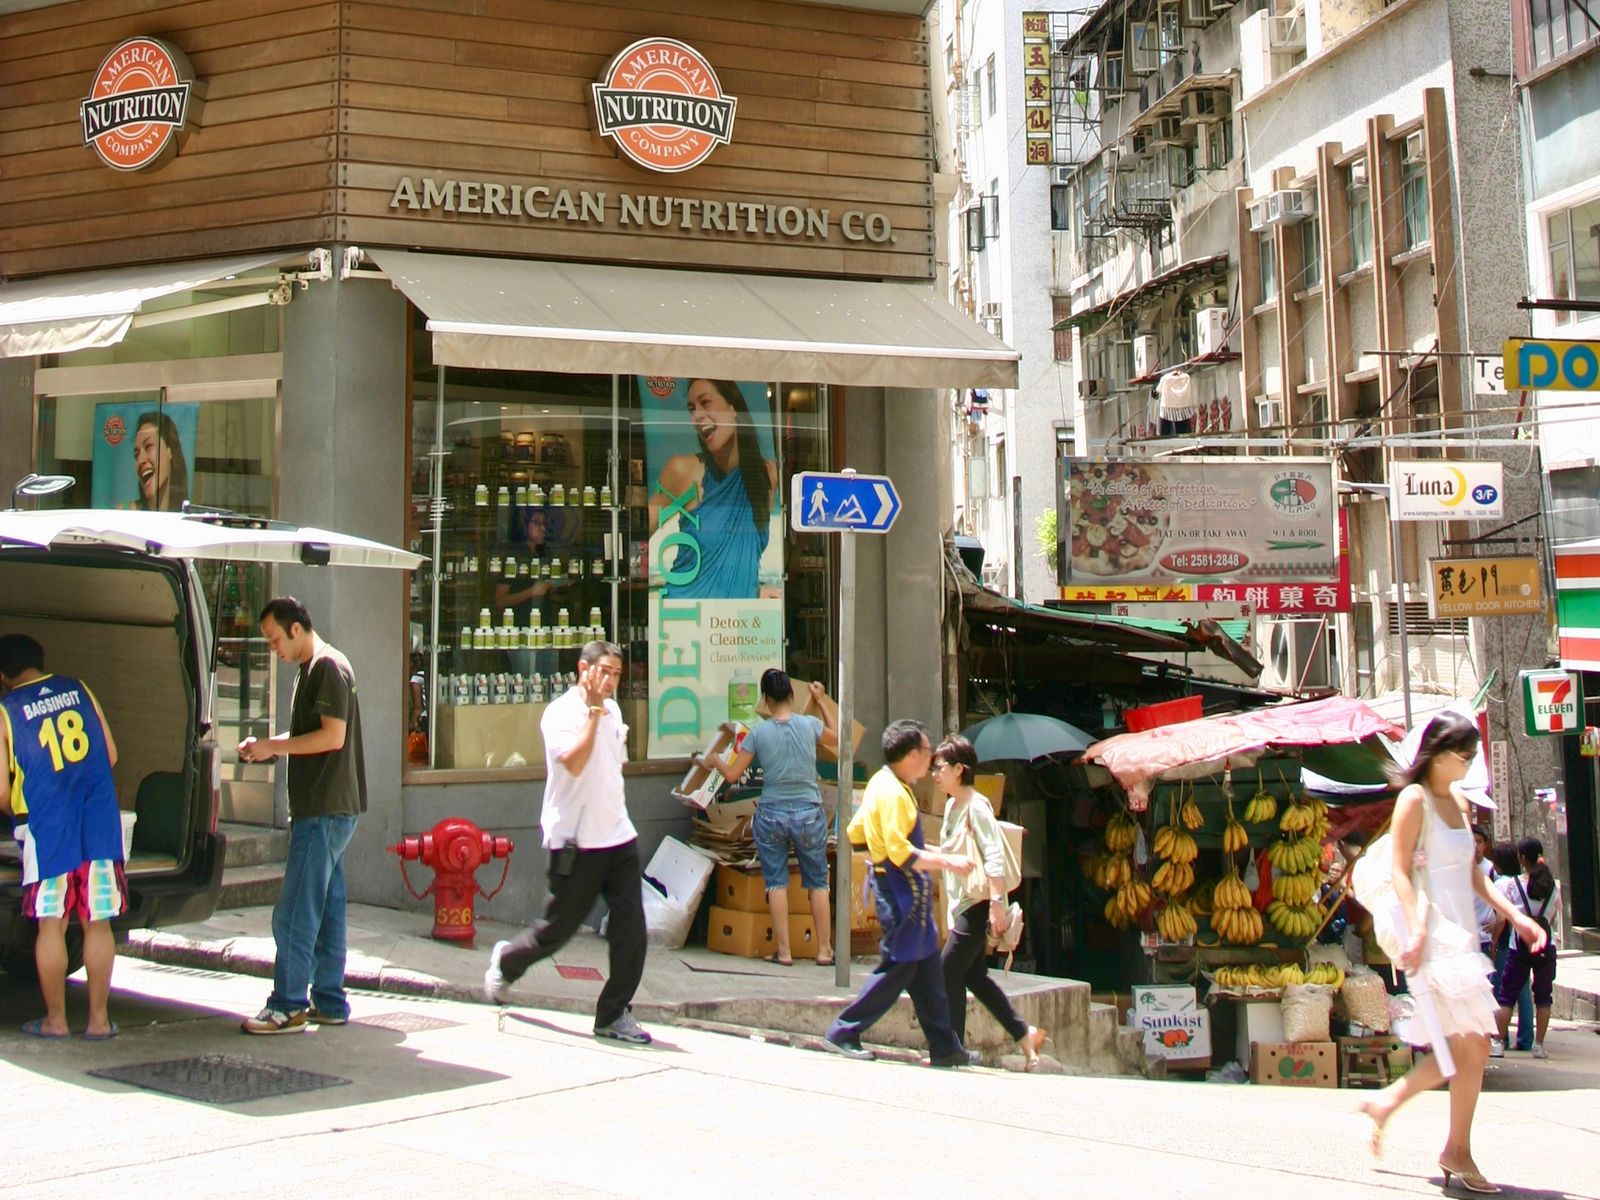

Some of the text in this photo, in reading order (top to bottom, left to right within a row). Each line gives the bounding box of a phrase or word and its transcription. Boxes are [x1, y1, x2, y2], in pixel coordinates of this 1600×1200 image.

[101, 47, 171, 93] AMERICAN
[621, 49, 710, 95] AMERICAN
[88, 92, 184, 134] NUTRITION
[604, 95, 728, 133] NUTRITION
[105, 127, 161, 156] COMPANY
[630, 130, 700, 158] COMPANY
[390, 177, 898, 245] AMERICAN NUTRITION CO.
[1519, 342, 1600, 390] DO
[1106, 482, 1139, 495] Slice
[1141, 483, 1153, 497] of
[1403, 472, 1455, 496] Luna
[1475, 489, 1494, 500] 3/F
[1122, 499, 1136, 511] A
[1137, 498, 1168, 511] Piece
[1169, 498, 1181, 511] of
[1189, 529, 1200, 538] OR
[1225, 529, 1248, 538] AWAY
[1171, 554, 1239, 567] Tel: 2581-2848
[656, 479, 702, 742] DETOX
[1439, 599, 1540, 613] YELLOW DOOR KITCHEN
[709, 616, 762, 629] Detox &
[709, 633, 776, 646] Cleanse with
[23, 690, 81, 721] BAGSINGIT
[38, 709, 90, 772] 18
[438, 907, 472, 925] 526
[1142, 1013, 1202, 1029] Sunkist
